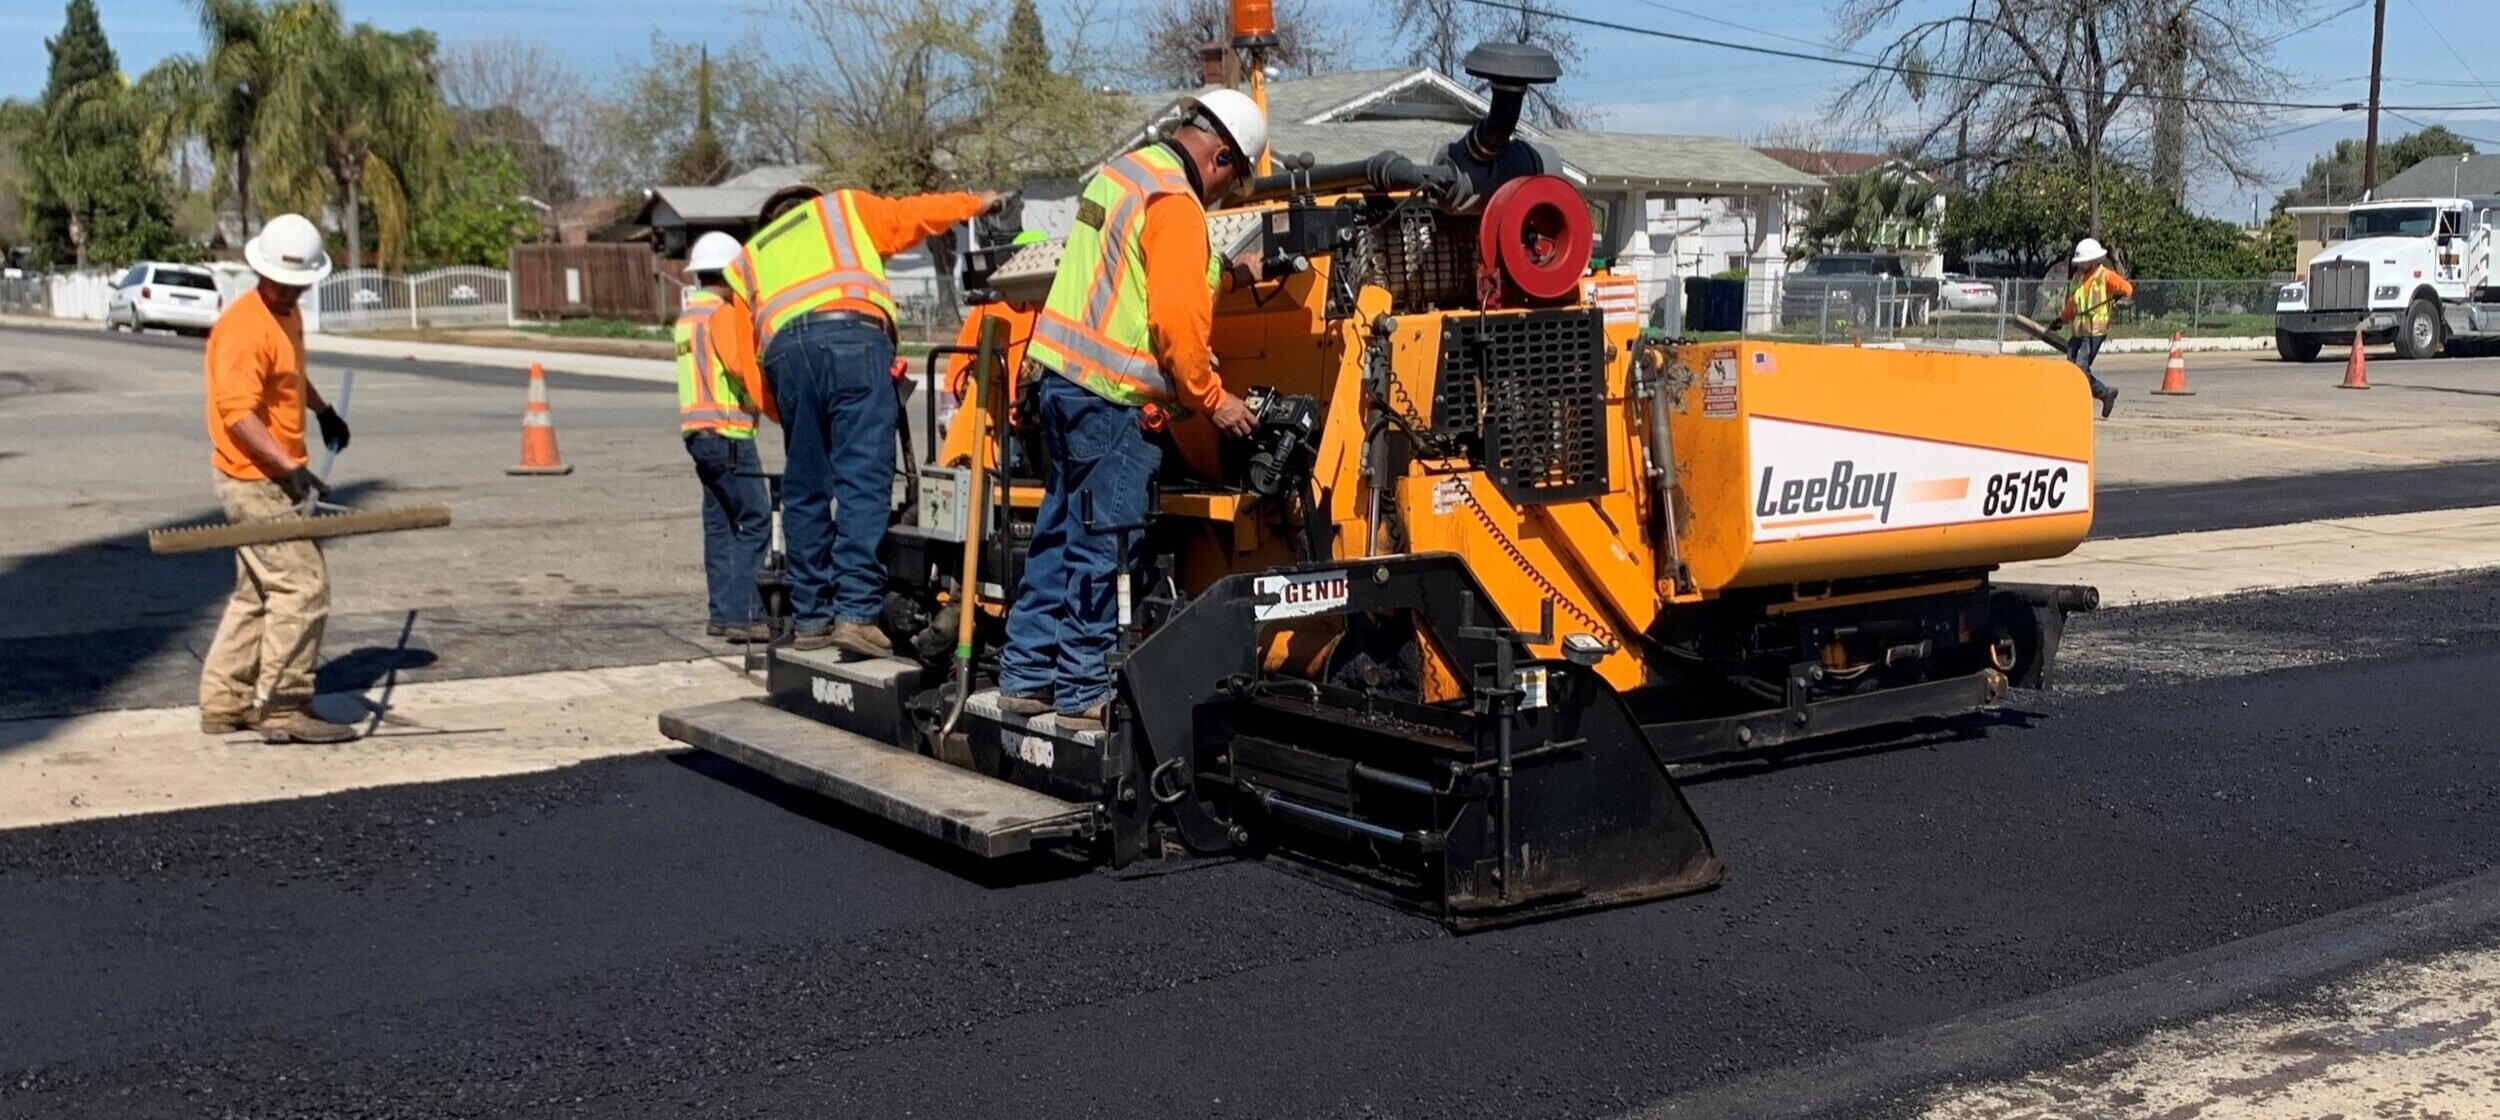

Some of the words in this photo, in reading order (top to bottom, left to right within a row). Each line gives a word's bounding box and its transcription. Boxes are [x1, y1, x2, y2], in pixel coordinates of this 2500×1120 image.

[1756, 460, 1898, 524] LeeBoy
[1982, 467, 2069, 517] 8515C
[1258, 579, 1346, 604] LGEND
